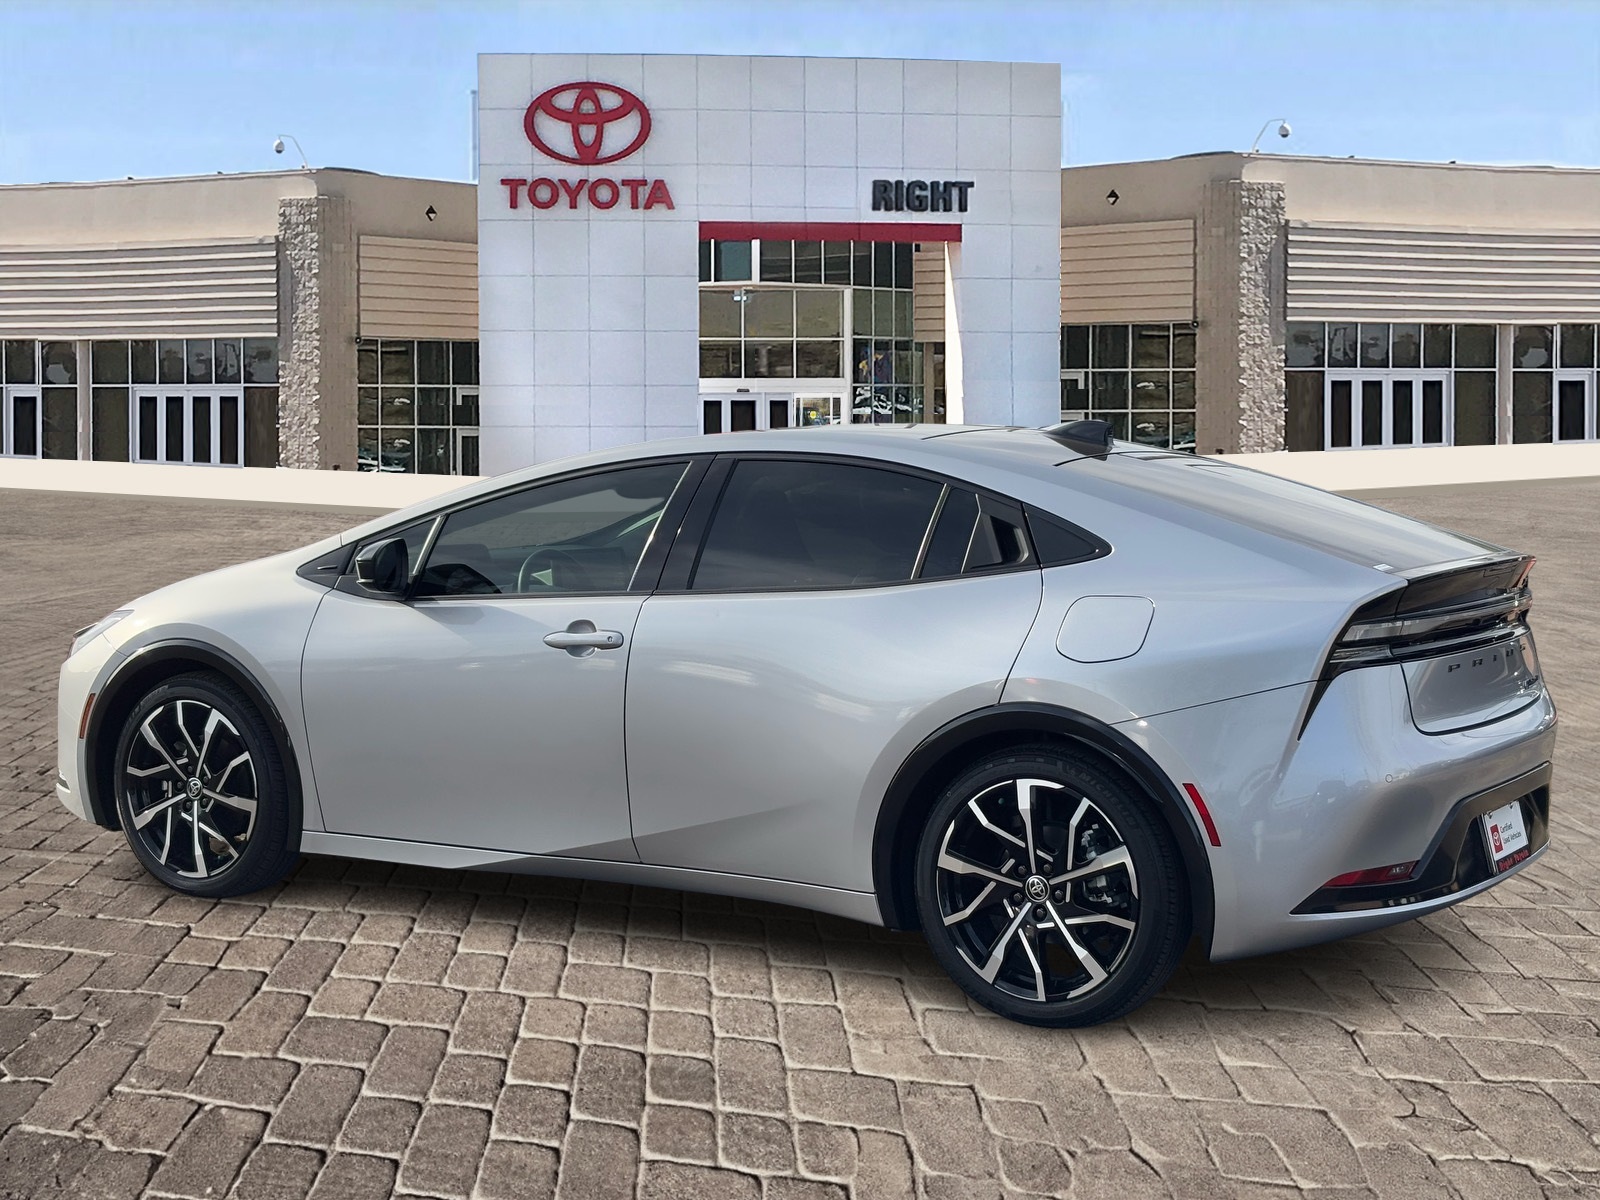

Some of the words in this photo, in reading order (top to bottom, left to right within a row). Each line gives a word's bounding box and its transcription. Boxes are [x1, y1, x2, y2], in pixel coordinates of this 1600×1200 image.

[500, 177, 676, 210] TOYOTA
[872, 179, 975, 212] RIGHT
[1447, 644, 1526, 673] PRIUS
[1500, 821, 1513, 833] Certified
